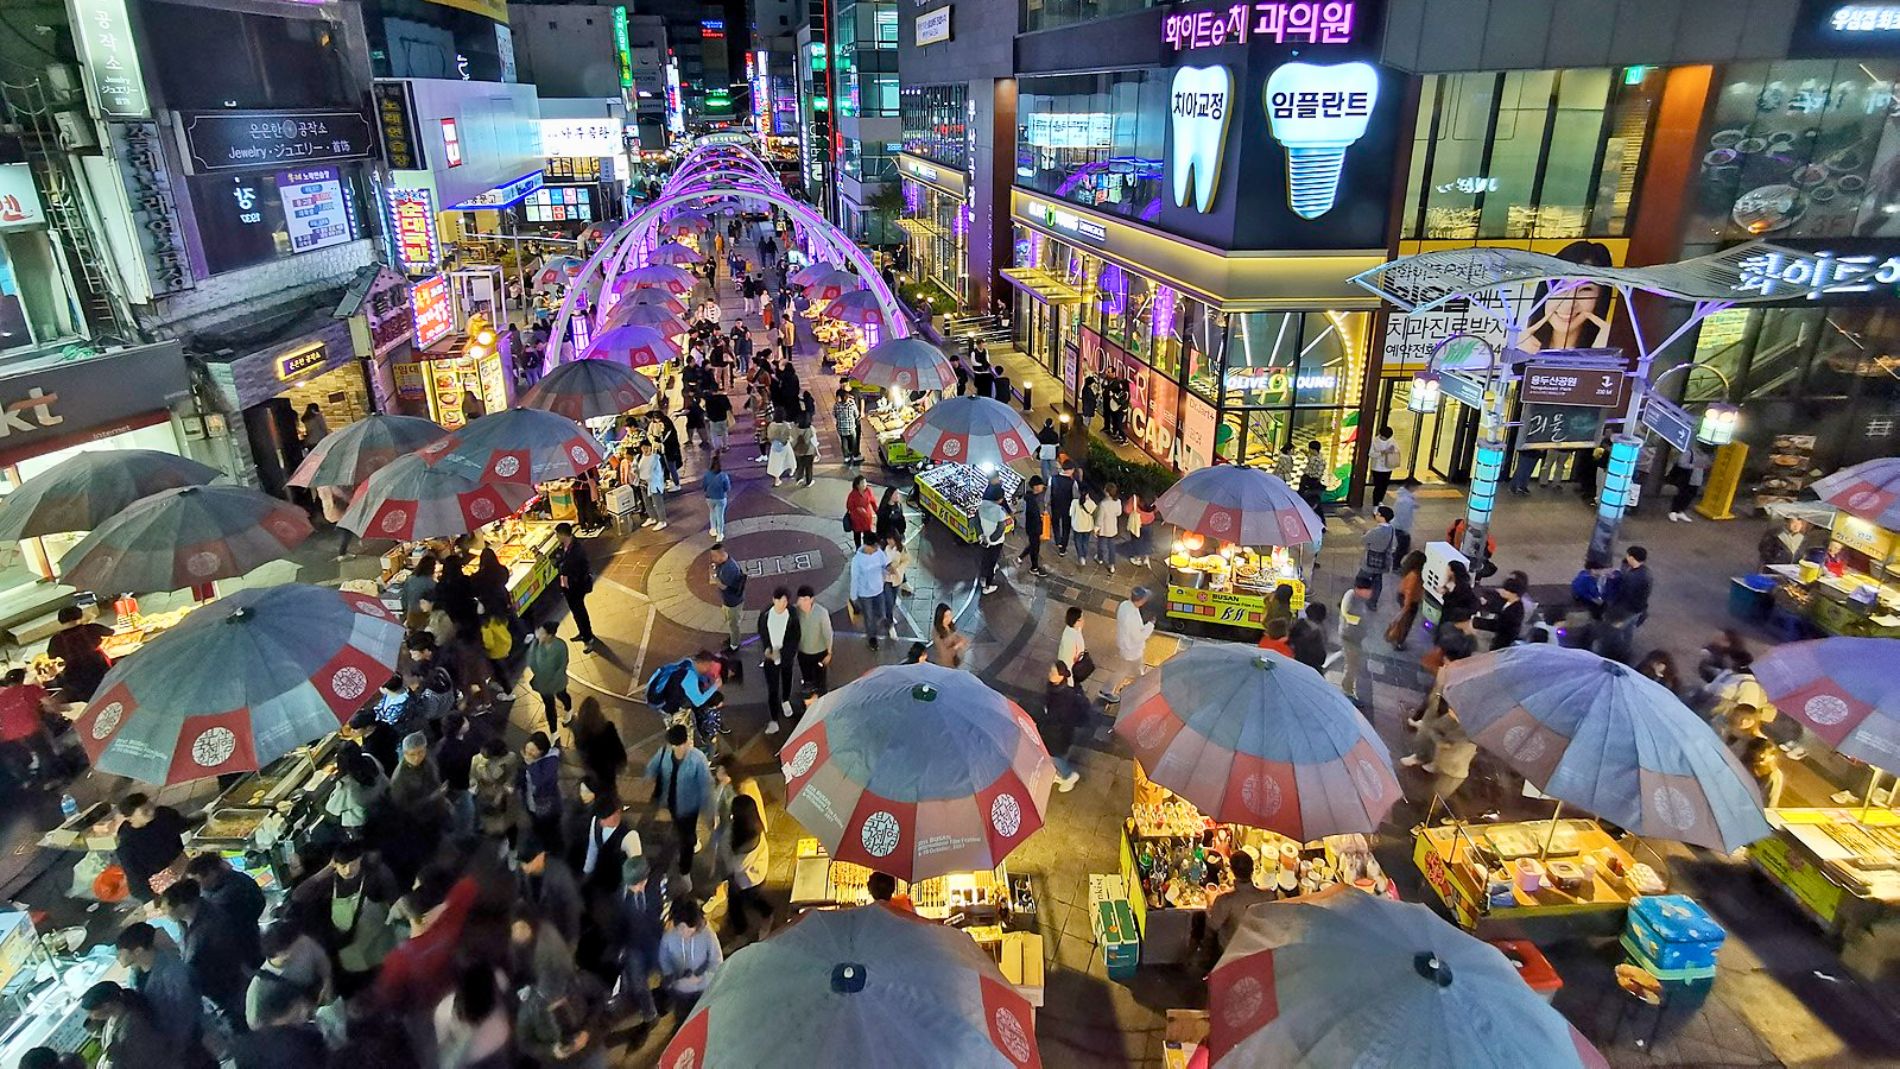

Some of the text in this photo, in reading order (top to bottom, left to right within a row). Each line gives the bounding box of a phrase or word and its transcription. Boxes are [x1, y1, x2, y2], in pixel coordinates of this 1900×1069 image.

[1173, 91, 1224, 120] 치아교정
[1272, 91, 1368, 119] 임플란트
[298, 121, 328, 137] 공작소
[228, 144, 267, 158] Jewelry
[1228, 376, 1268, 389] OLIVE
[1531, 375, 1578, 388] 용두산공원
[0, 386, 64, 438] kt
[1212, 593, 1240, 602] BUSAN
